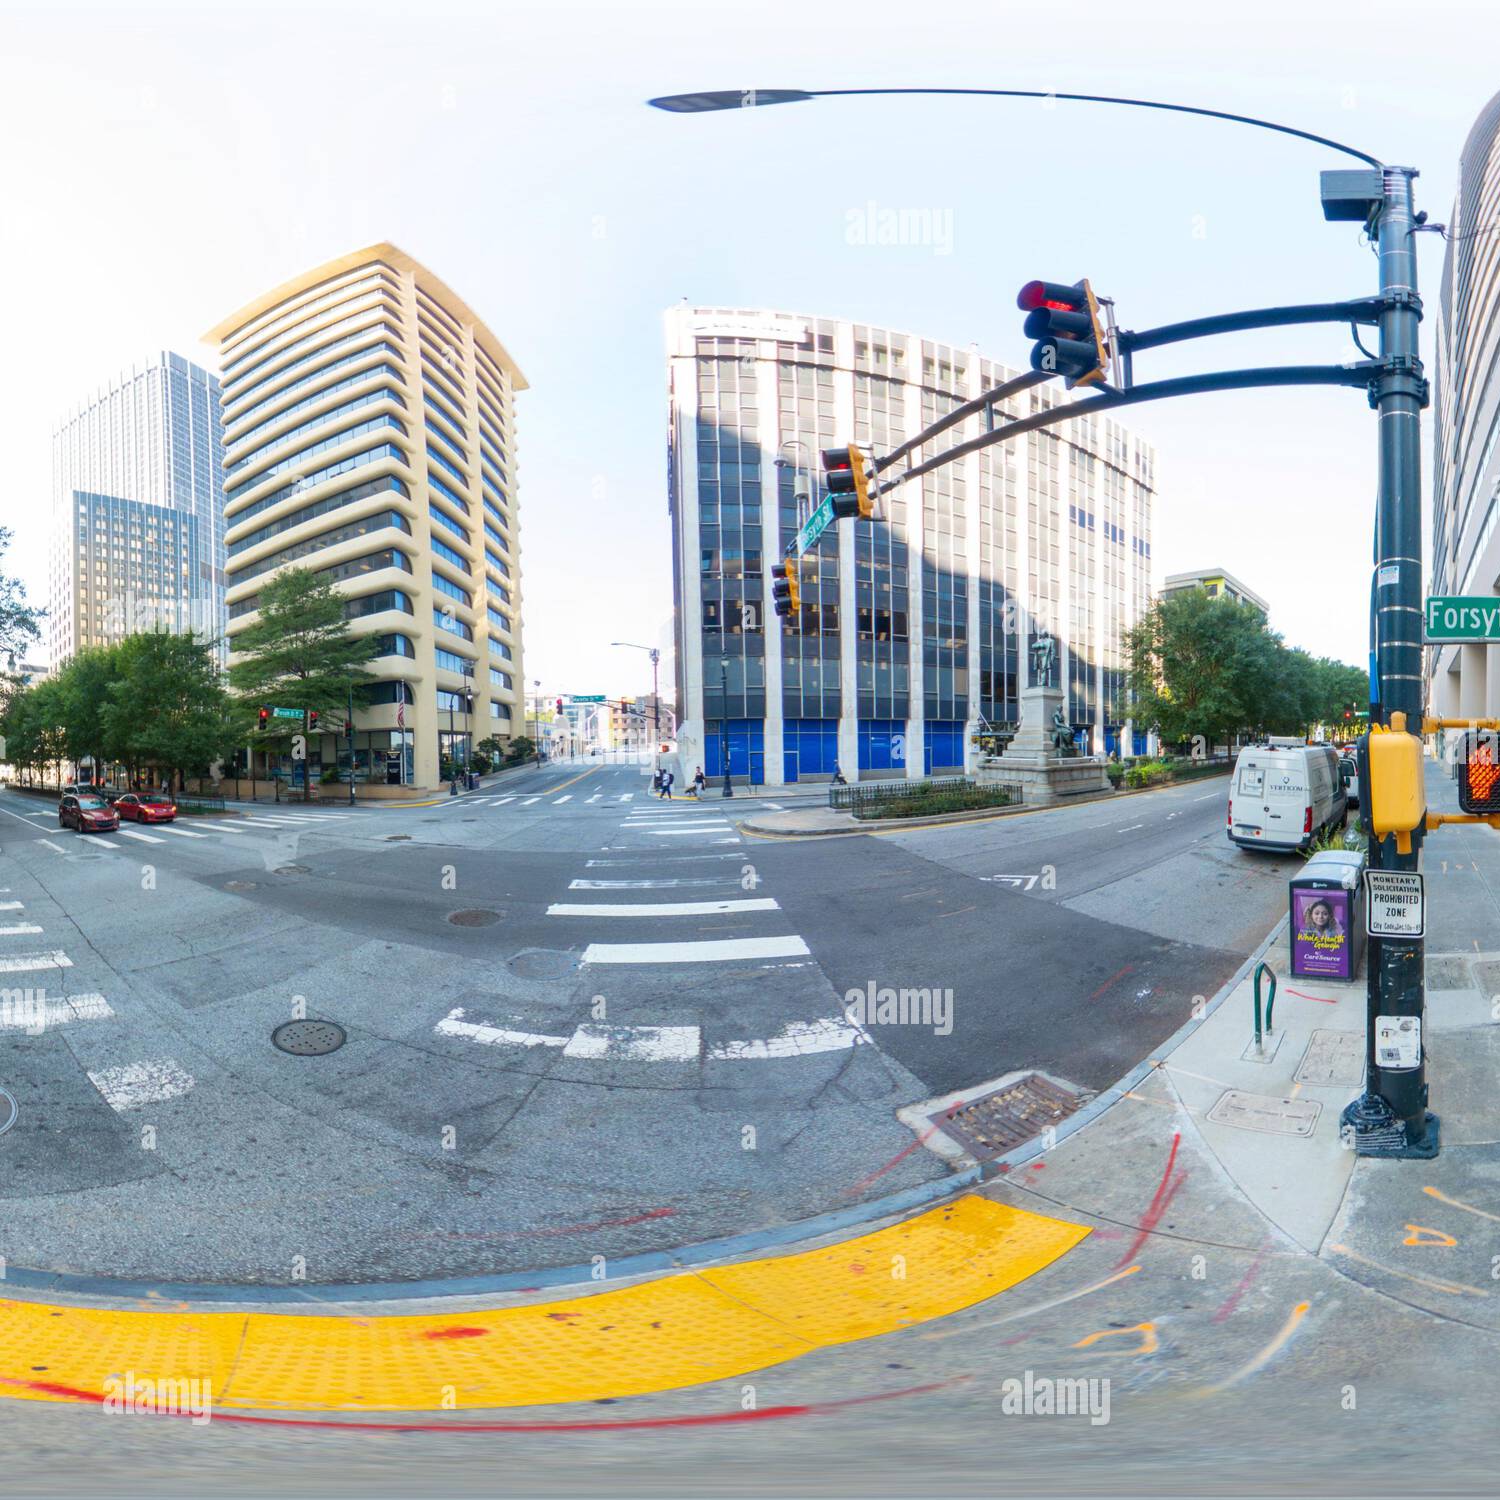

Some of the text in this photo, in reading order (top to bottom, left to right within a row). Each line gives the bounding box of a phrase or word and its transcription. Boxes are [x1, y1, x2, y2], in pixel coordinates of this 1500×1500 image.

[1373, 876, 1416, 885] MONETARY
[1373, 884, 1419, 894] SOLICITATION
[1374, 893, 1418, 905] PROHIBITED
[1386, 907, 1407, 918] ZONE
[1304, 953, 1341, 962] CareSource
